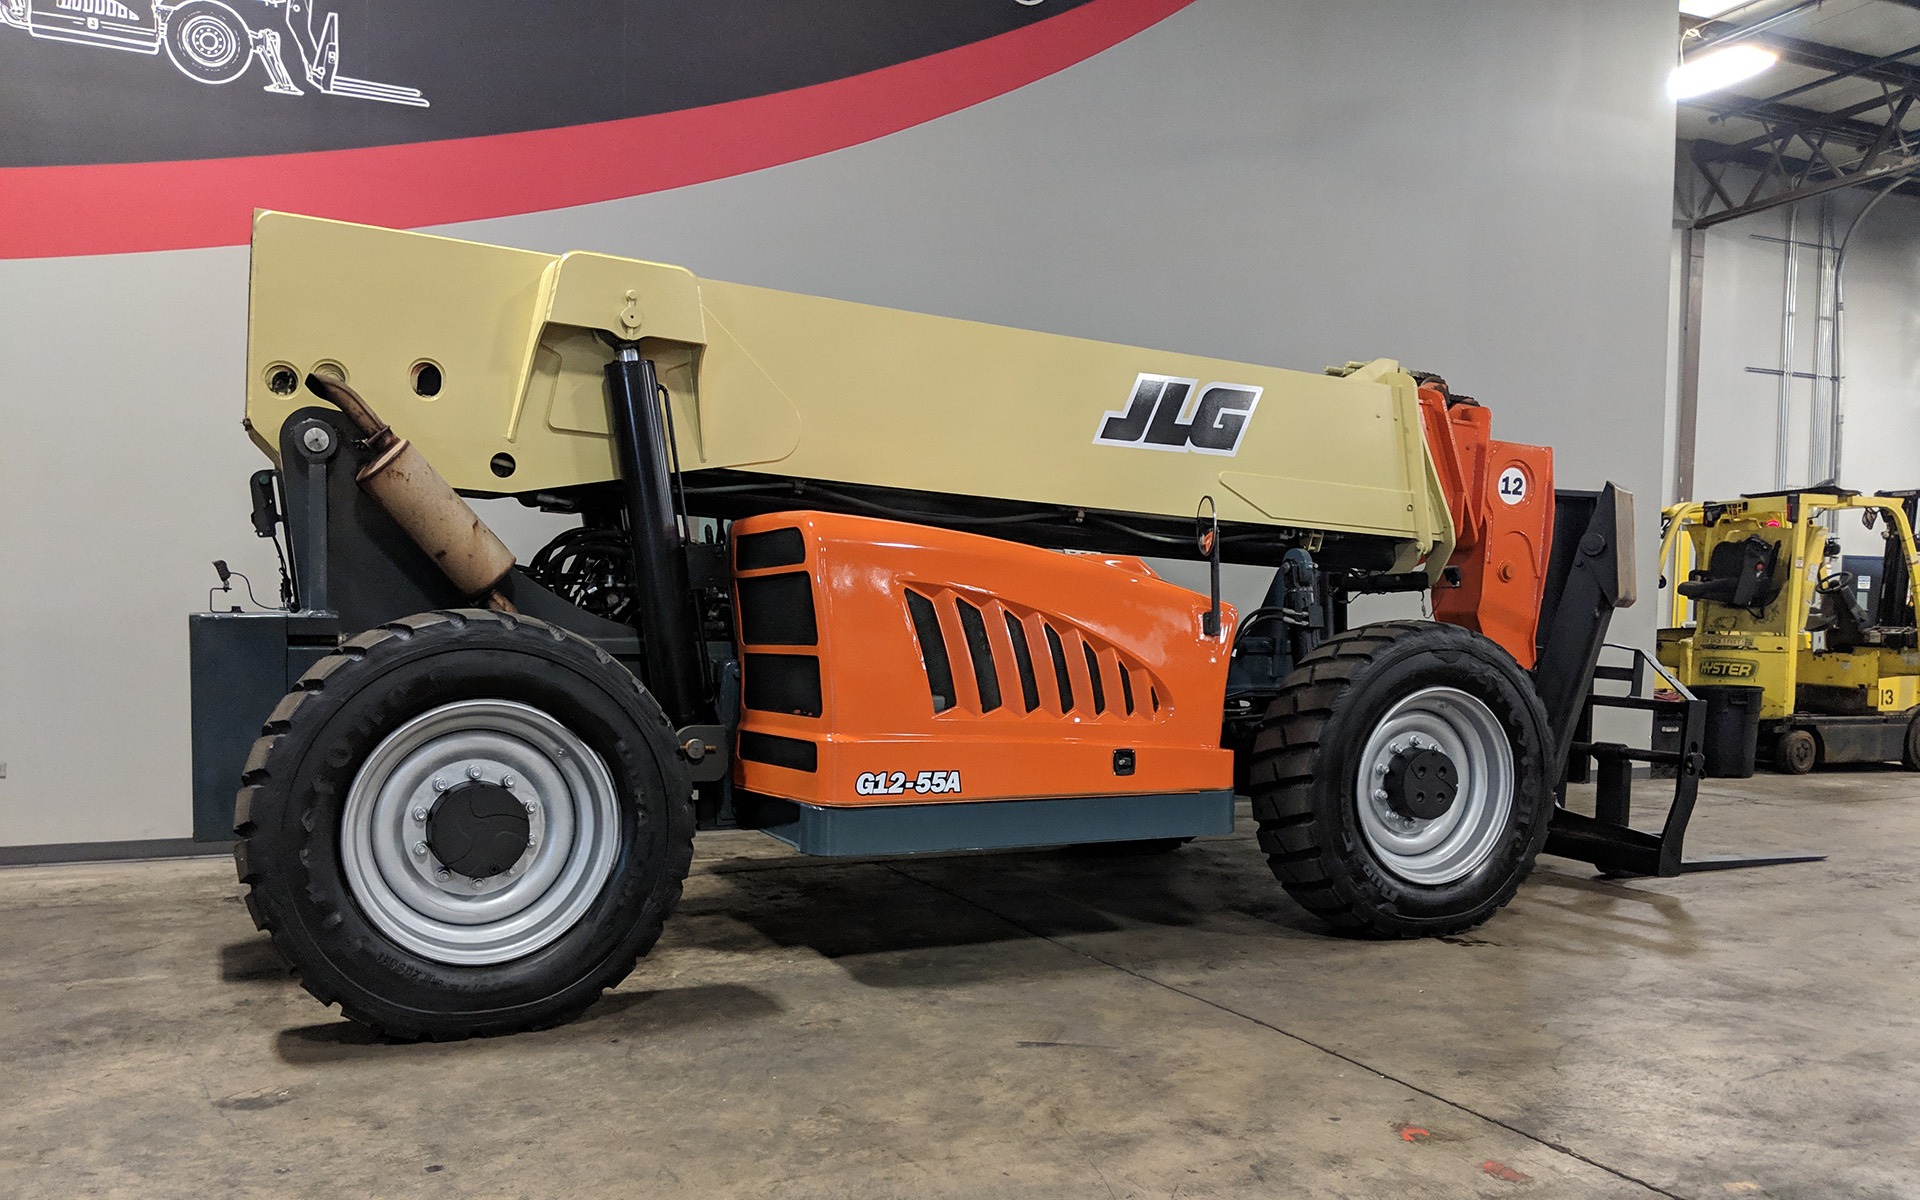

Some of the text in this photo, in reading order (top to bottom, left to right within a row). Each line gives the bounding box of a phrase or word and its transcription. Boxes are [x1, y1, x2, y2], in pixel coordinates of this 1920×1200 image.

[1098, 377, 1259, 452] JLG
[1501, 476, 1524, 496] 12
[1700, 661, 1752, 676] HYSTER
[1881, 689, 1894, 706] 13
[855, 770, 962, 795] G12-55A
